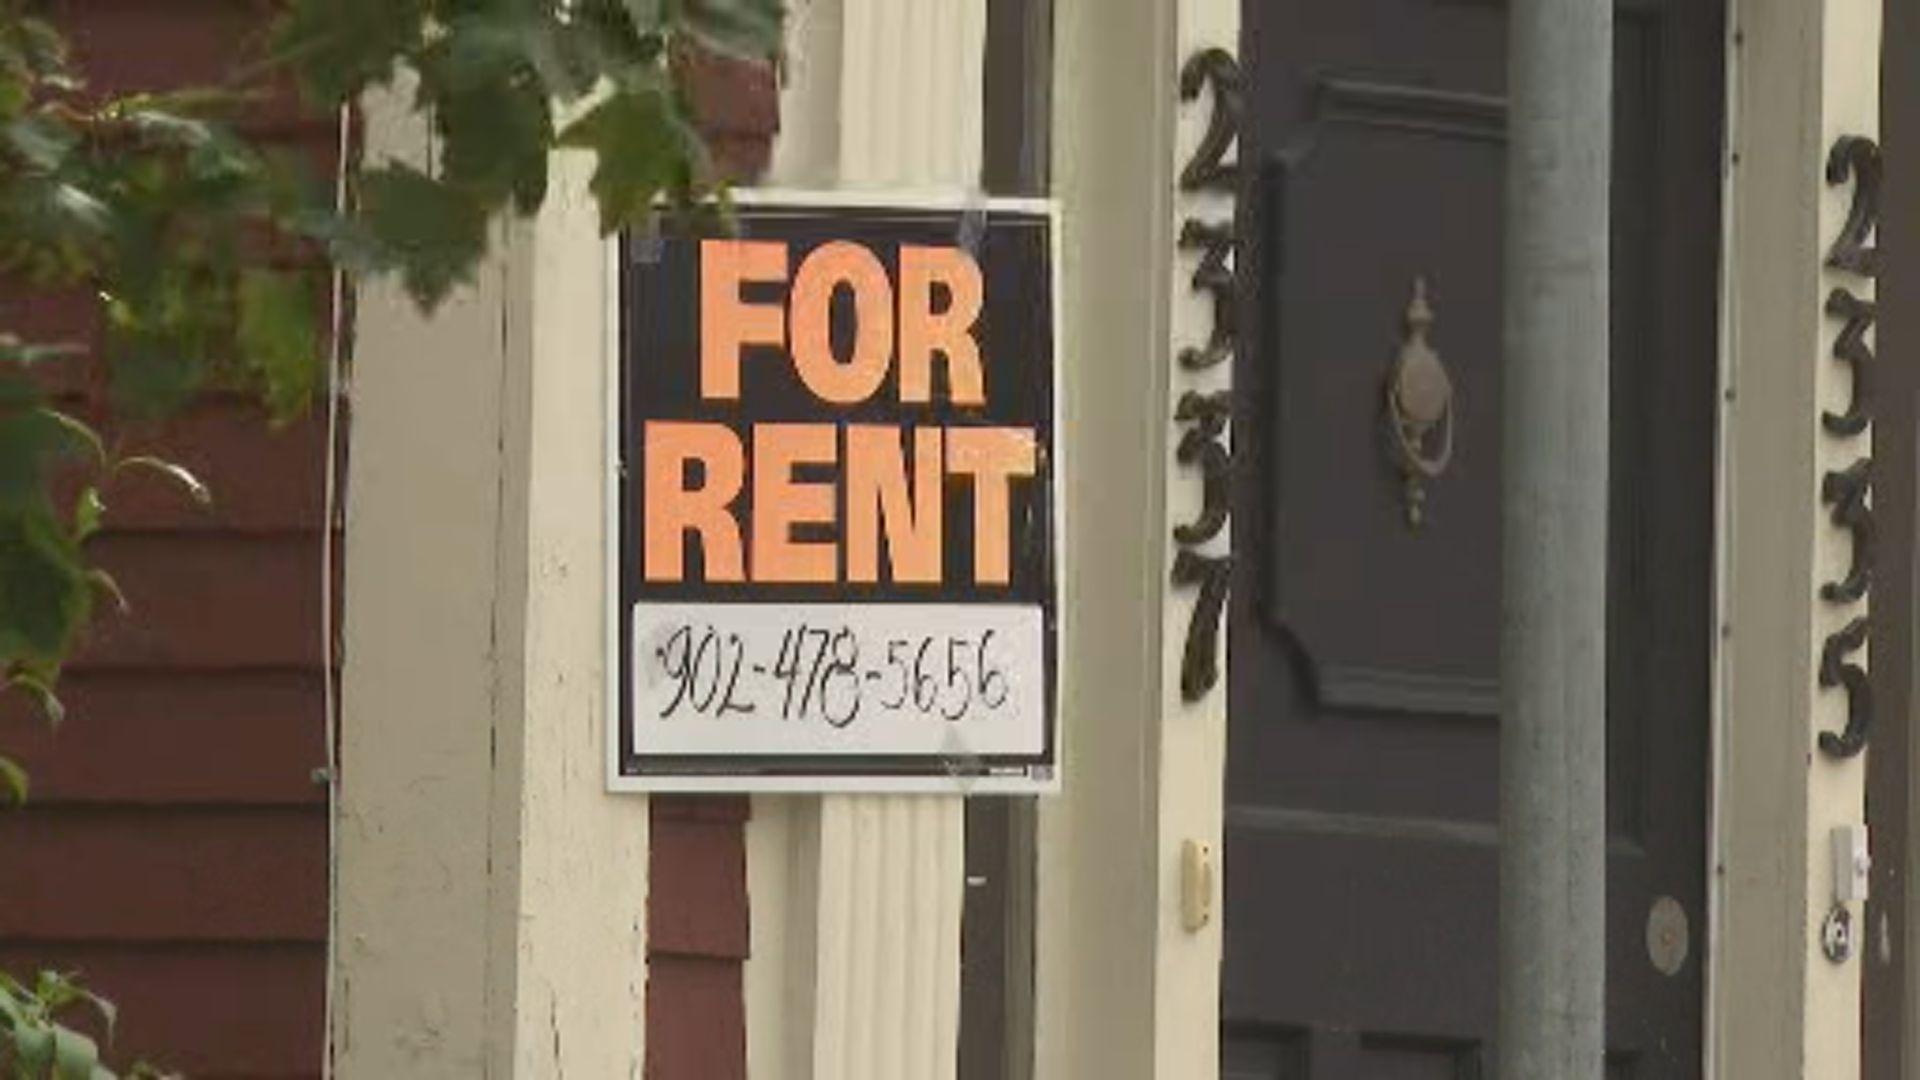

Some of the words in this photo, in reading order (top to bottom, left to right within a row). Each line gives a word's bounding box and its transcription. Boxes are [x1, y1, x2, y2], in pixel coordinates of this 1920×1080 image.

[701, 239, 986, 406] FOR
[1171, 47, 1241, 704] 2337
[643, 420, 1036, 583] RENT
[1818, 135, 1882, 757] 2335
[655, 623, 1009, 728] 902-478-5656
